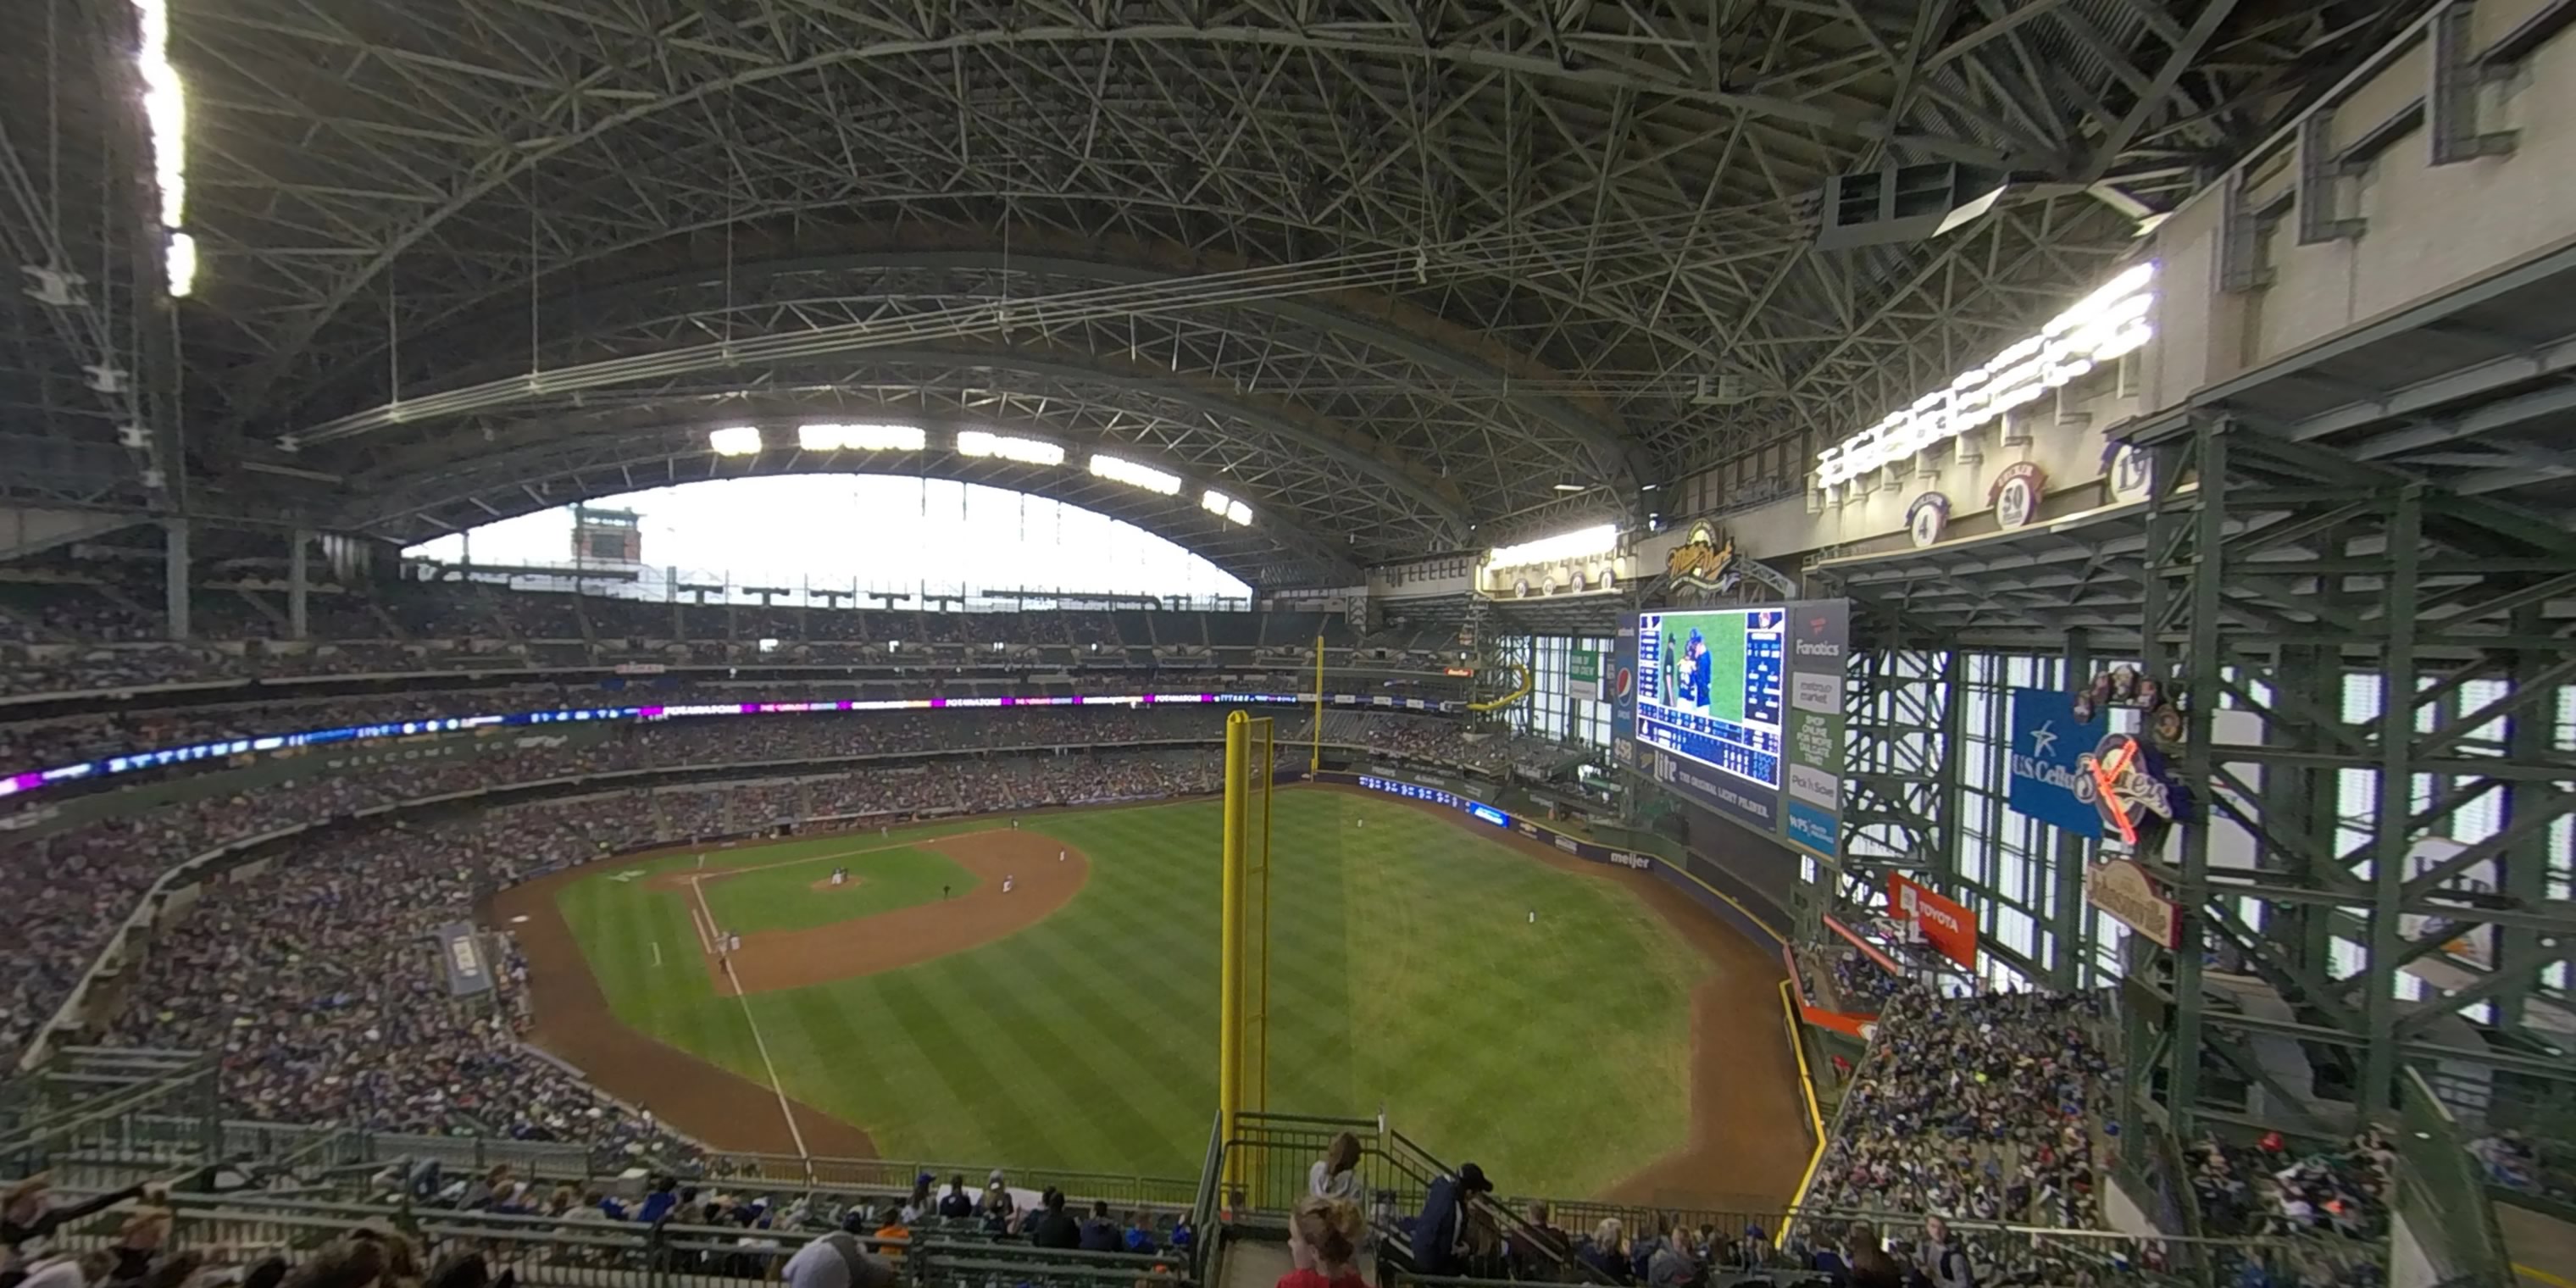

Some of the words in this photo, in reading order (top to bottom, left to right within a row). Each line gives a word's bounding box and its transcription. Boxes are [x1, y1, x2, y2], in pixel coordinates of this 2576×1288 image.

[1918, 514, 1929, 539] 4
[1796, 639, 1840, 656] Fanatics
[1806, 715, 1825, 726] SHOP
[1796, 731, 1810, 742] FOR
[1812, 736, 1833, 749] MORE
[1802, 724, 1828, 738] ONLINE
[1799, 741, 1830, 758] TAILGATE
[1653, 750, 1677, 782] Lite
[1679, 771, 1690, 784] THE
[1690, 776, 1718, 796] ORIGINAL
[1718, 786, 1738, 804] LIGHT
[1789, 814, 1808, 832] WPS
[1611, 852, 1650, 869] meijer
[1918, 901, 1959, 934] TOYOTA
